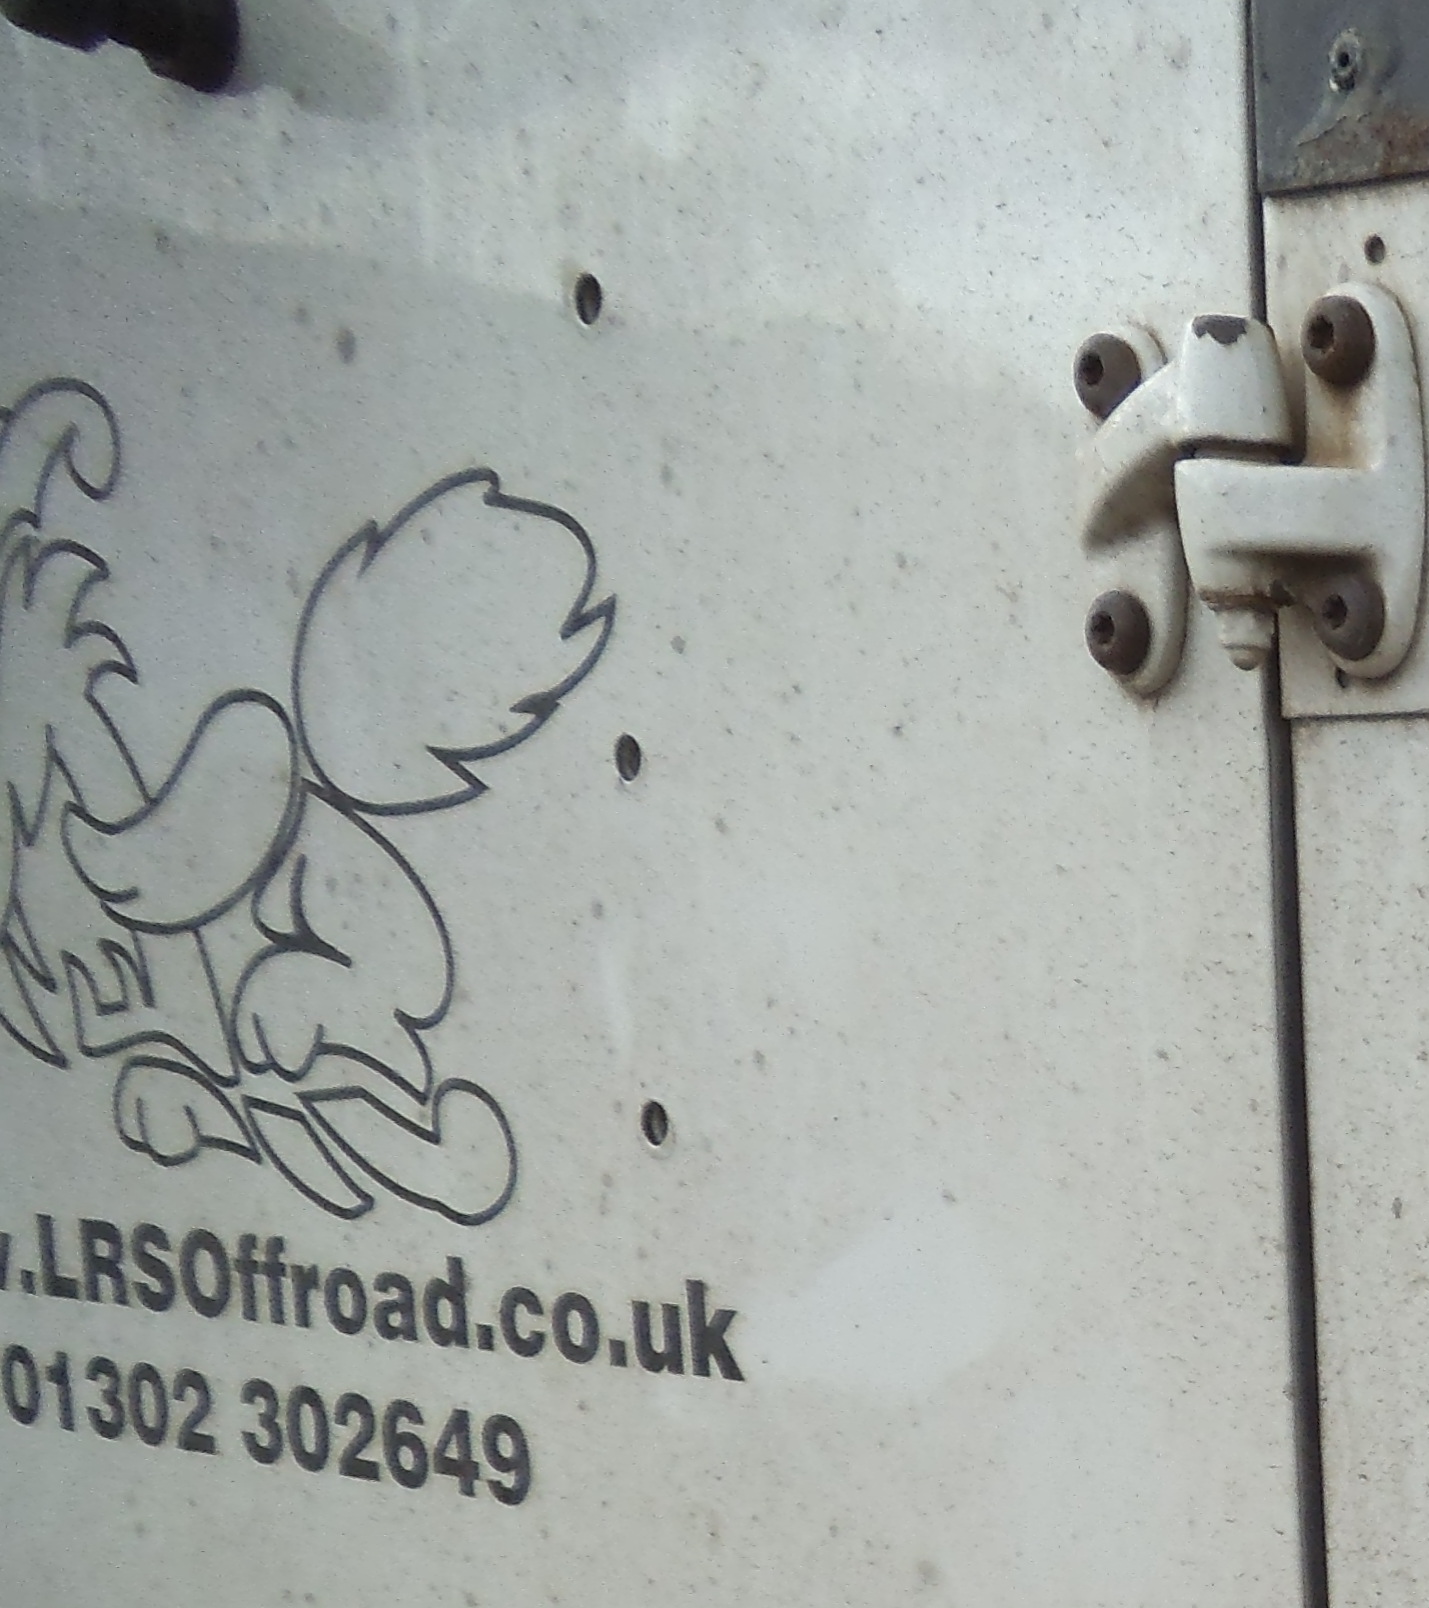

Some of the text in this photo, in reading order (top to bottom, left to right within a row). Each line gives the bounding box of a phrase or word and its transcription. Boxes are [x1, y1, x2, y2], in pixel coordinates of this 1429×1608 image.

[0, 1212, 745, 1381] .LRSOffroad.co.uk
[2, 1343, 532, 1506] 01302 302649
